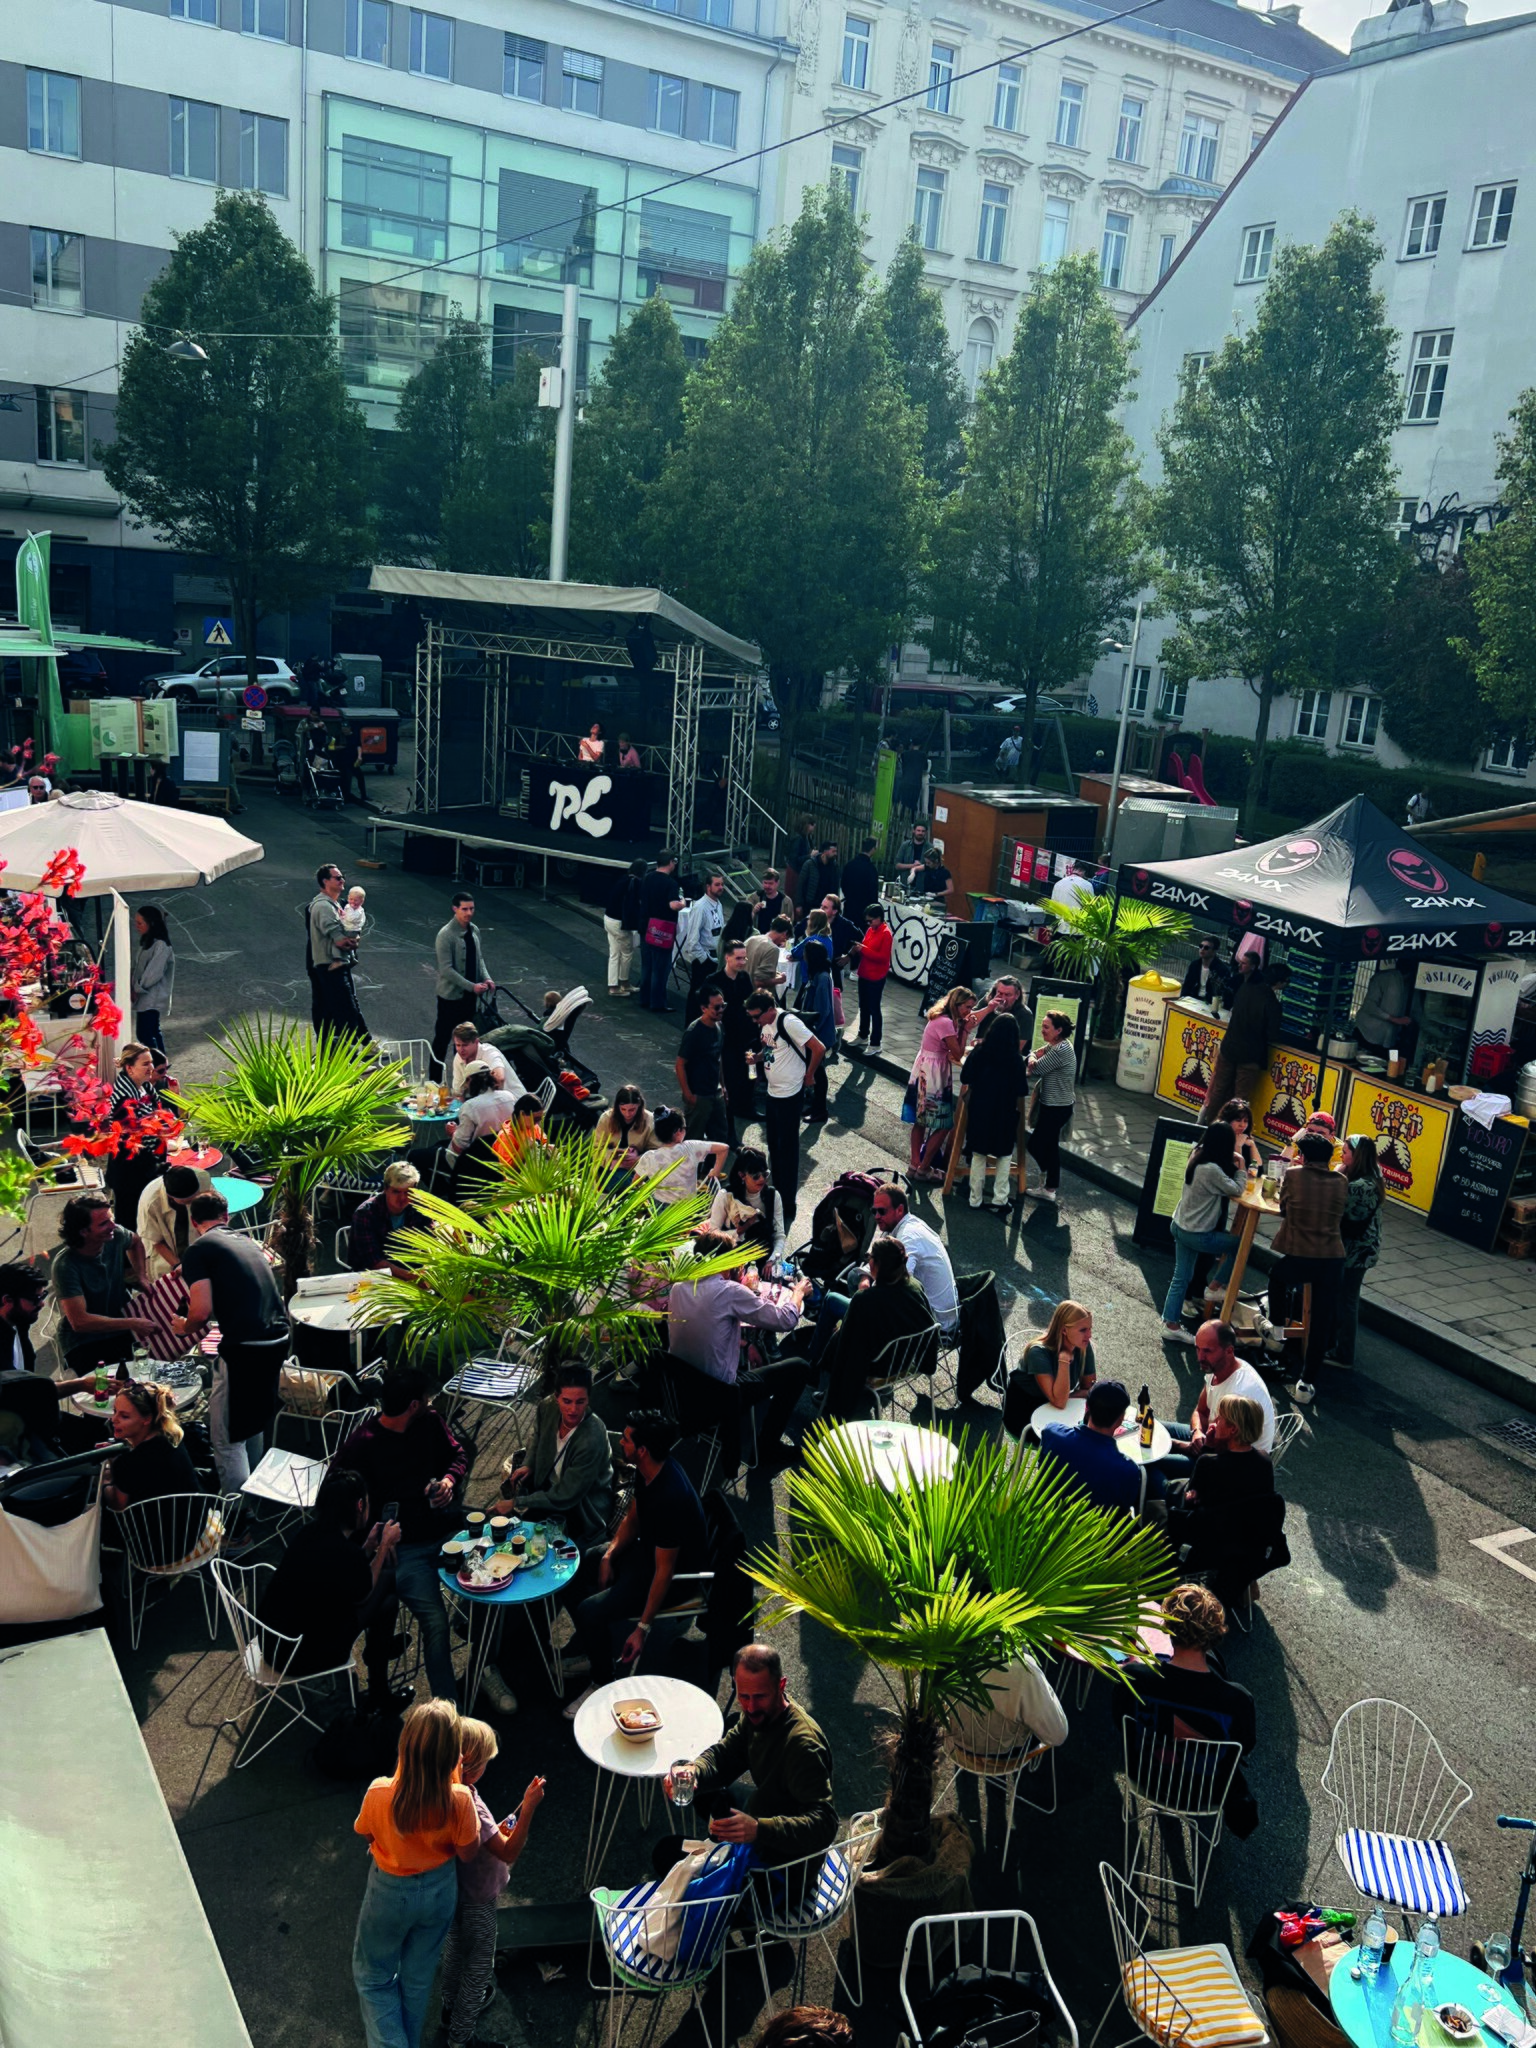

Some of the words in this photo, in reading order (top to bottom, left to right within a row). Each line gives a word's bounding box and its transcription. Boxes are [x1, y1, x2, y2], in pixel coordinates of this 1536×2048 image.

[1214, 867, 1293, 893] 24MX
[1150, 881, 1211, 911] 24MX
[1404, 896, 1487, 909] 24MX
[1254, 911, 1325, 949] 24MX
[1386, 931, 1458, 952] 24MX
[1507, 930, 1536, 947] 24
[1140, 1017, 1162, 1026] FLASCHEN
[1178, 1081, 1205, 1095] OBERTRUM
[1181, 1091, 1203, 1103] ORIGINA
[1266, 1118, 1297, 1133] OBERTRUM
[1270, 1128, 1291, 1139] ORIGI
[1381, 1167, 1410, 1183] TRUMER
